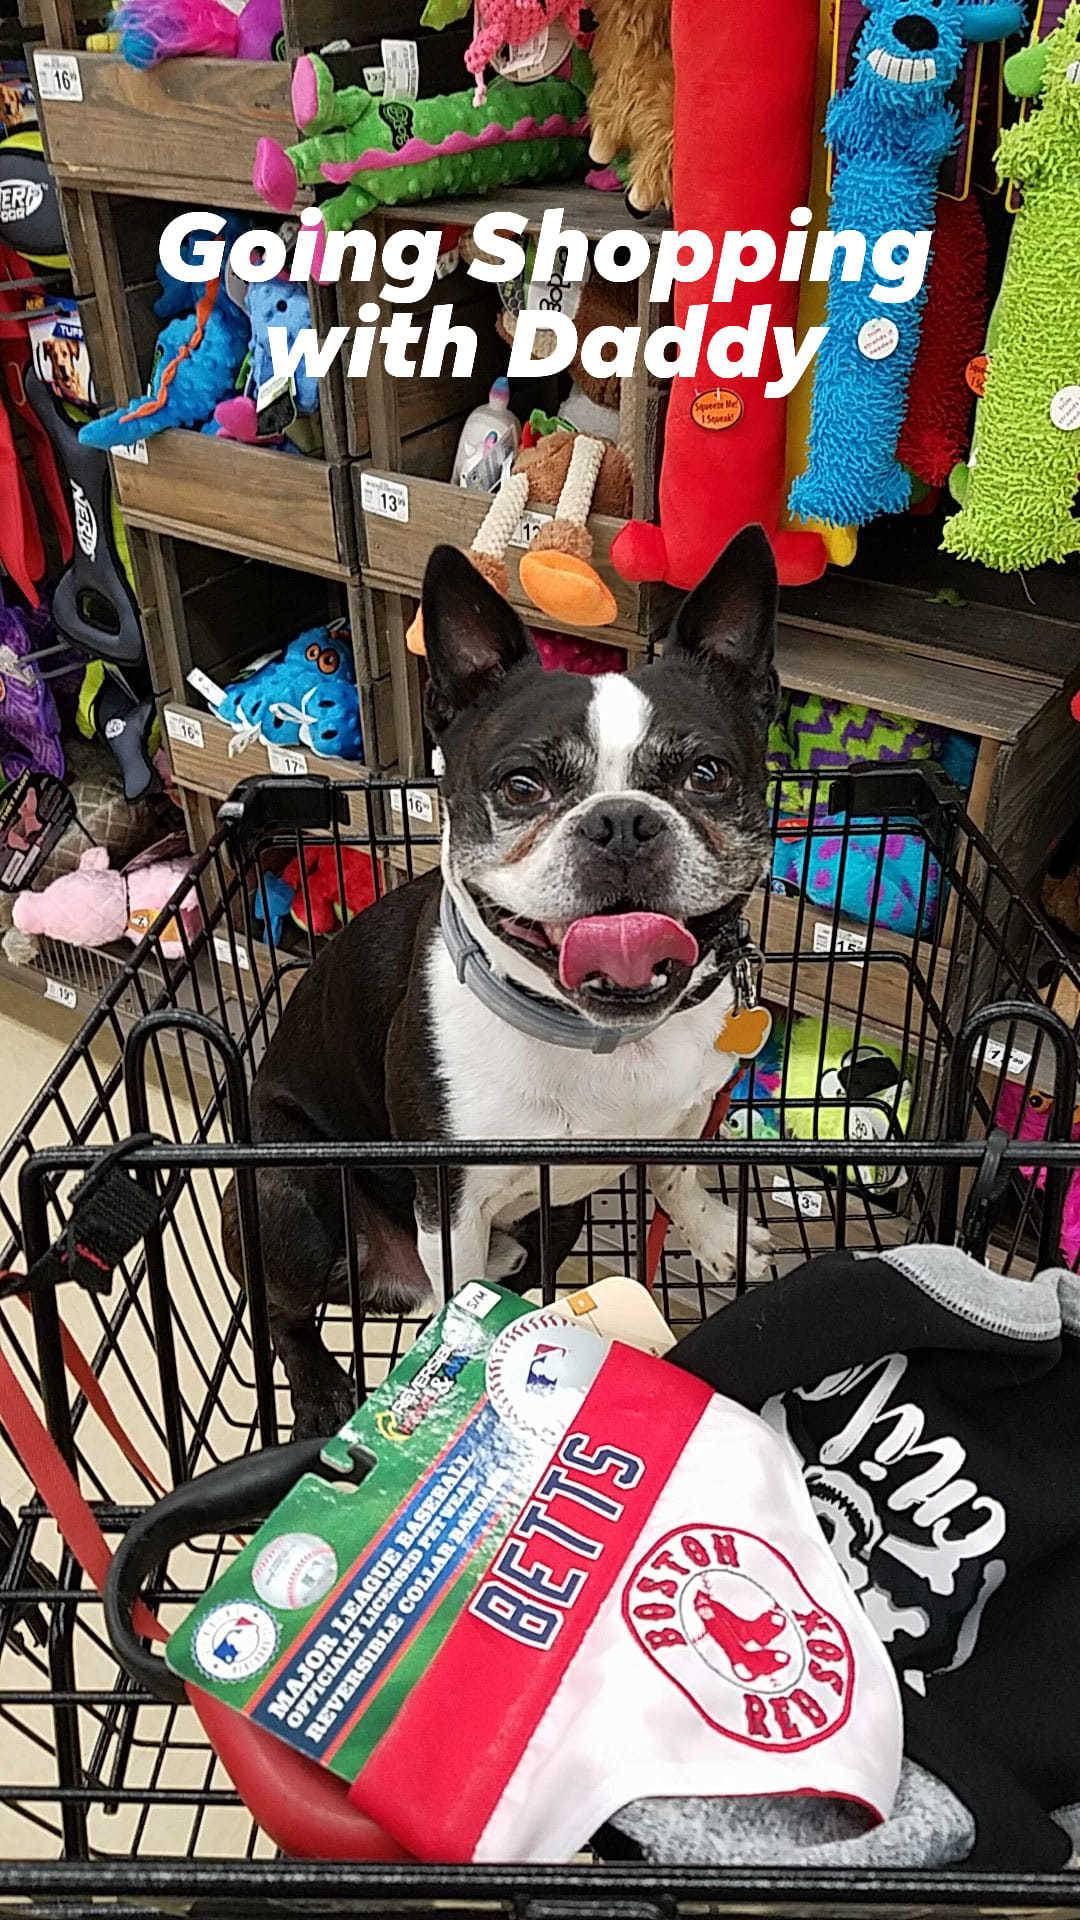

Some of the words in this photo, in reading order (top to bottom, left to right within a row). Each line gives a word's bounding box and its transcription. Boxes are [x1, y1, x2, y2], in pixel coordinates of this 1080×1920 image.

[0, 179, 44, 216] ERF
[70, 478, 98, 558] NERF
[466, 1290, 488, 1310] S/M
[391, 1338, 453, 1415] REVERSIB
[267, 1633, 339, 1720] MAJOR
[330, 1547, 403, 1635] LEAGUE
[394, 1453, 477, 1550] BASEBALL
[286, 1626, 365, 1729] OFFICIALLY
[359, 1548, 424, 1629] LICENSED
[417, 1515, 448, 1551] PET
[439, 1476, 478, 1519] WEAR
[468, 1431, 647, 1652] BETTS
[632, 1532, 740, 1651] BOSTON
[304, 1613, 405, 1743] REVERSIBLE
[398, 1542, 458, 1614] COLLAR
[743, 1691, 829, 1740] RED
[792, 1609, 846, 1698] SOX
